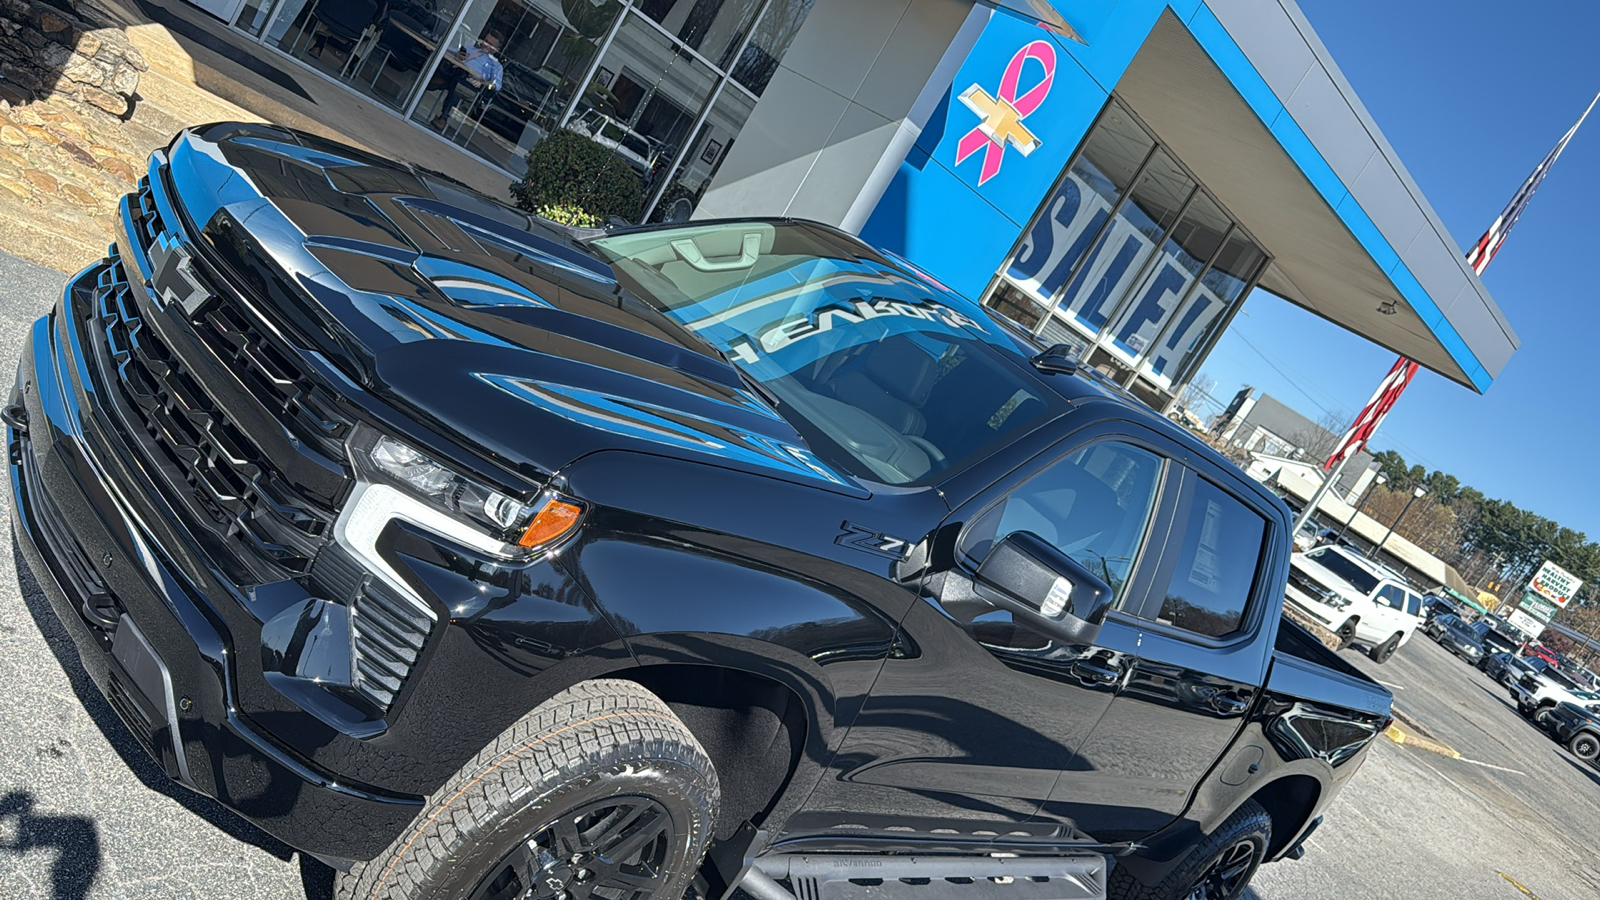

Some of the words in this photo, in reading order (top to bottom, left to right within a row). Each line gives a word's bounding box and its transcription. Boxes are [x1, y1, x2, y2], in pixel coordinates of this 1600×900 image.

[1005, 176, 1212, 377] SALE!
[1541, 573, 1571, 593] HARVEST
[1542, 567, 1570, 585] HEALTHY
[1540, 579, 1570, 600] PRODUCE
